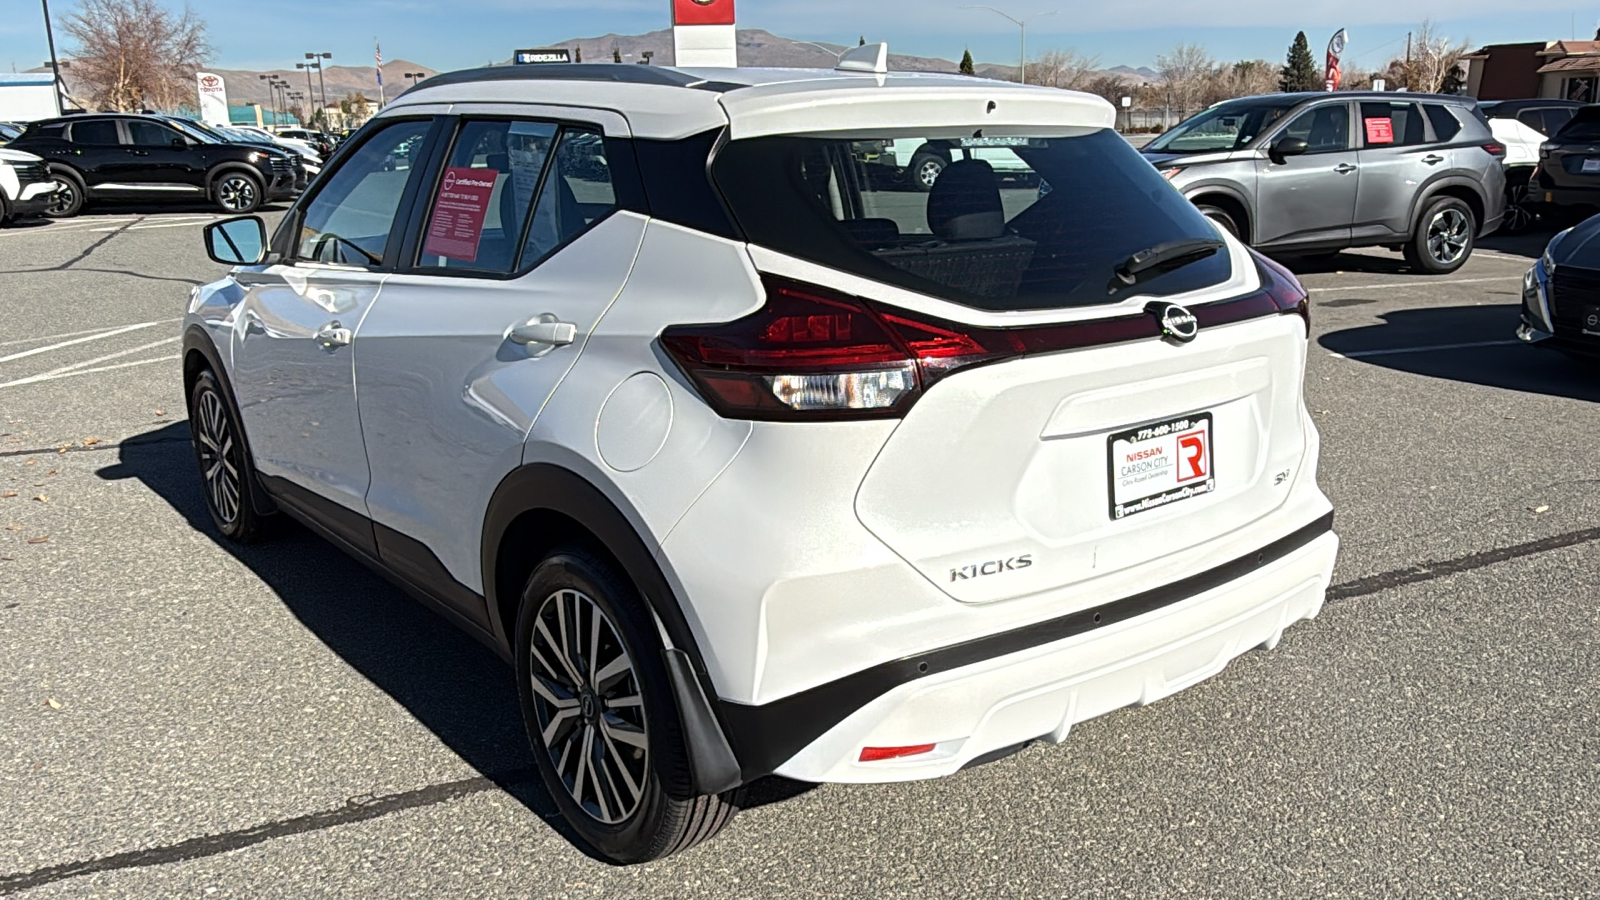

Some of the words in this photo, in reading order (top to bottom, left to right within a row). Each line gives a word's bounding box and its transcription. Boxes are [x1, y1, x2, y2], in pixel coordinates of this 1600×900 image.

[530, 53, 568, 62] RIDEZILLA
[1126, 446, 1163, 463] NISSAN
[1121, 460, 1153, 477] CARSON
[1153, 455, 1169, 468] CITY
[1273, 468, 1290, 487] SV
[1124, 484, 1207, 515] www.NissanCarsonCity.com
[949, 554, 1033, 583] KICKS
